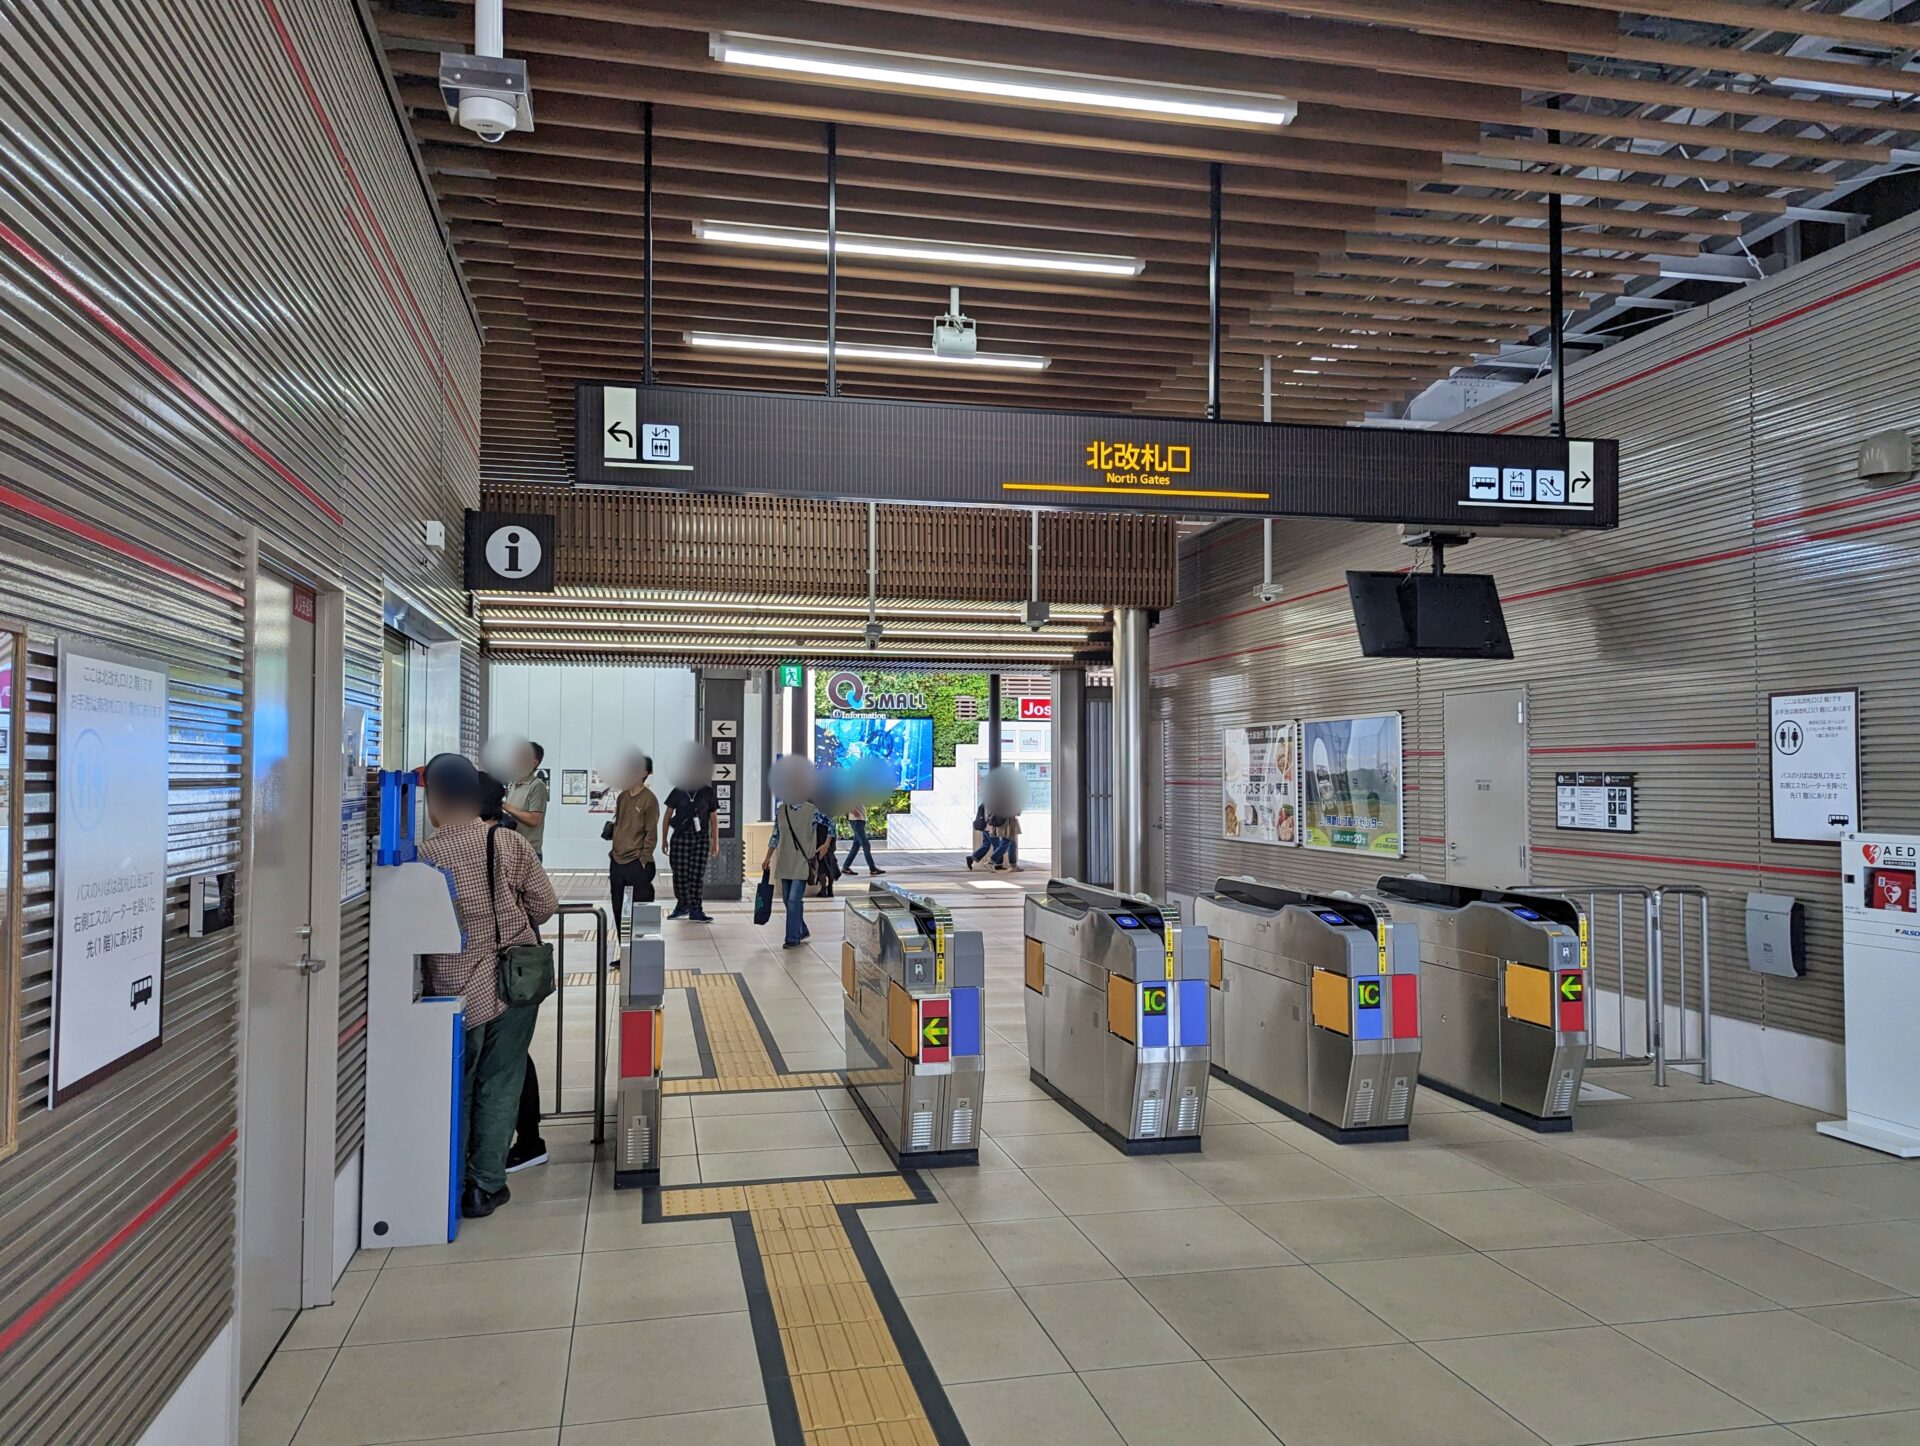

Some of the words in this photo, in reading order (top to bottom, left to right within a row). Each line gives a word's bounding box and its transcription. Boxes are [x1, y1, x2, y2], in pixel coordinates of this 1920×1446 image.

[1086, 441, 1190, 472] 北改札口
[1106, 473, 1138, 484] North
[1140, 474, 1171, 485] Gates
[879, 693, 927, 709] MALL
[1883, 846, 1916, 857] AED
[1143, 990, 1166, 1012] IC
[1358, 983, 1380, 1004] IC
